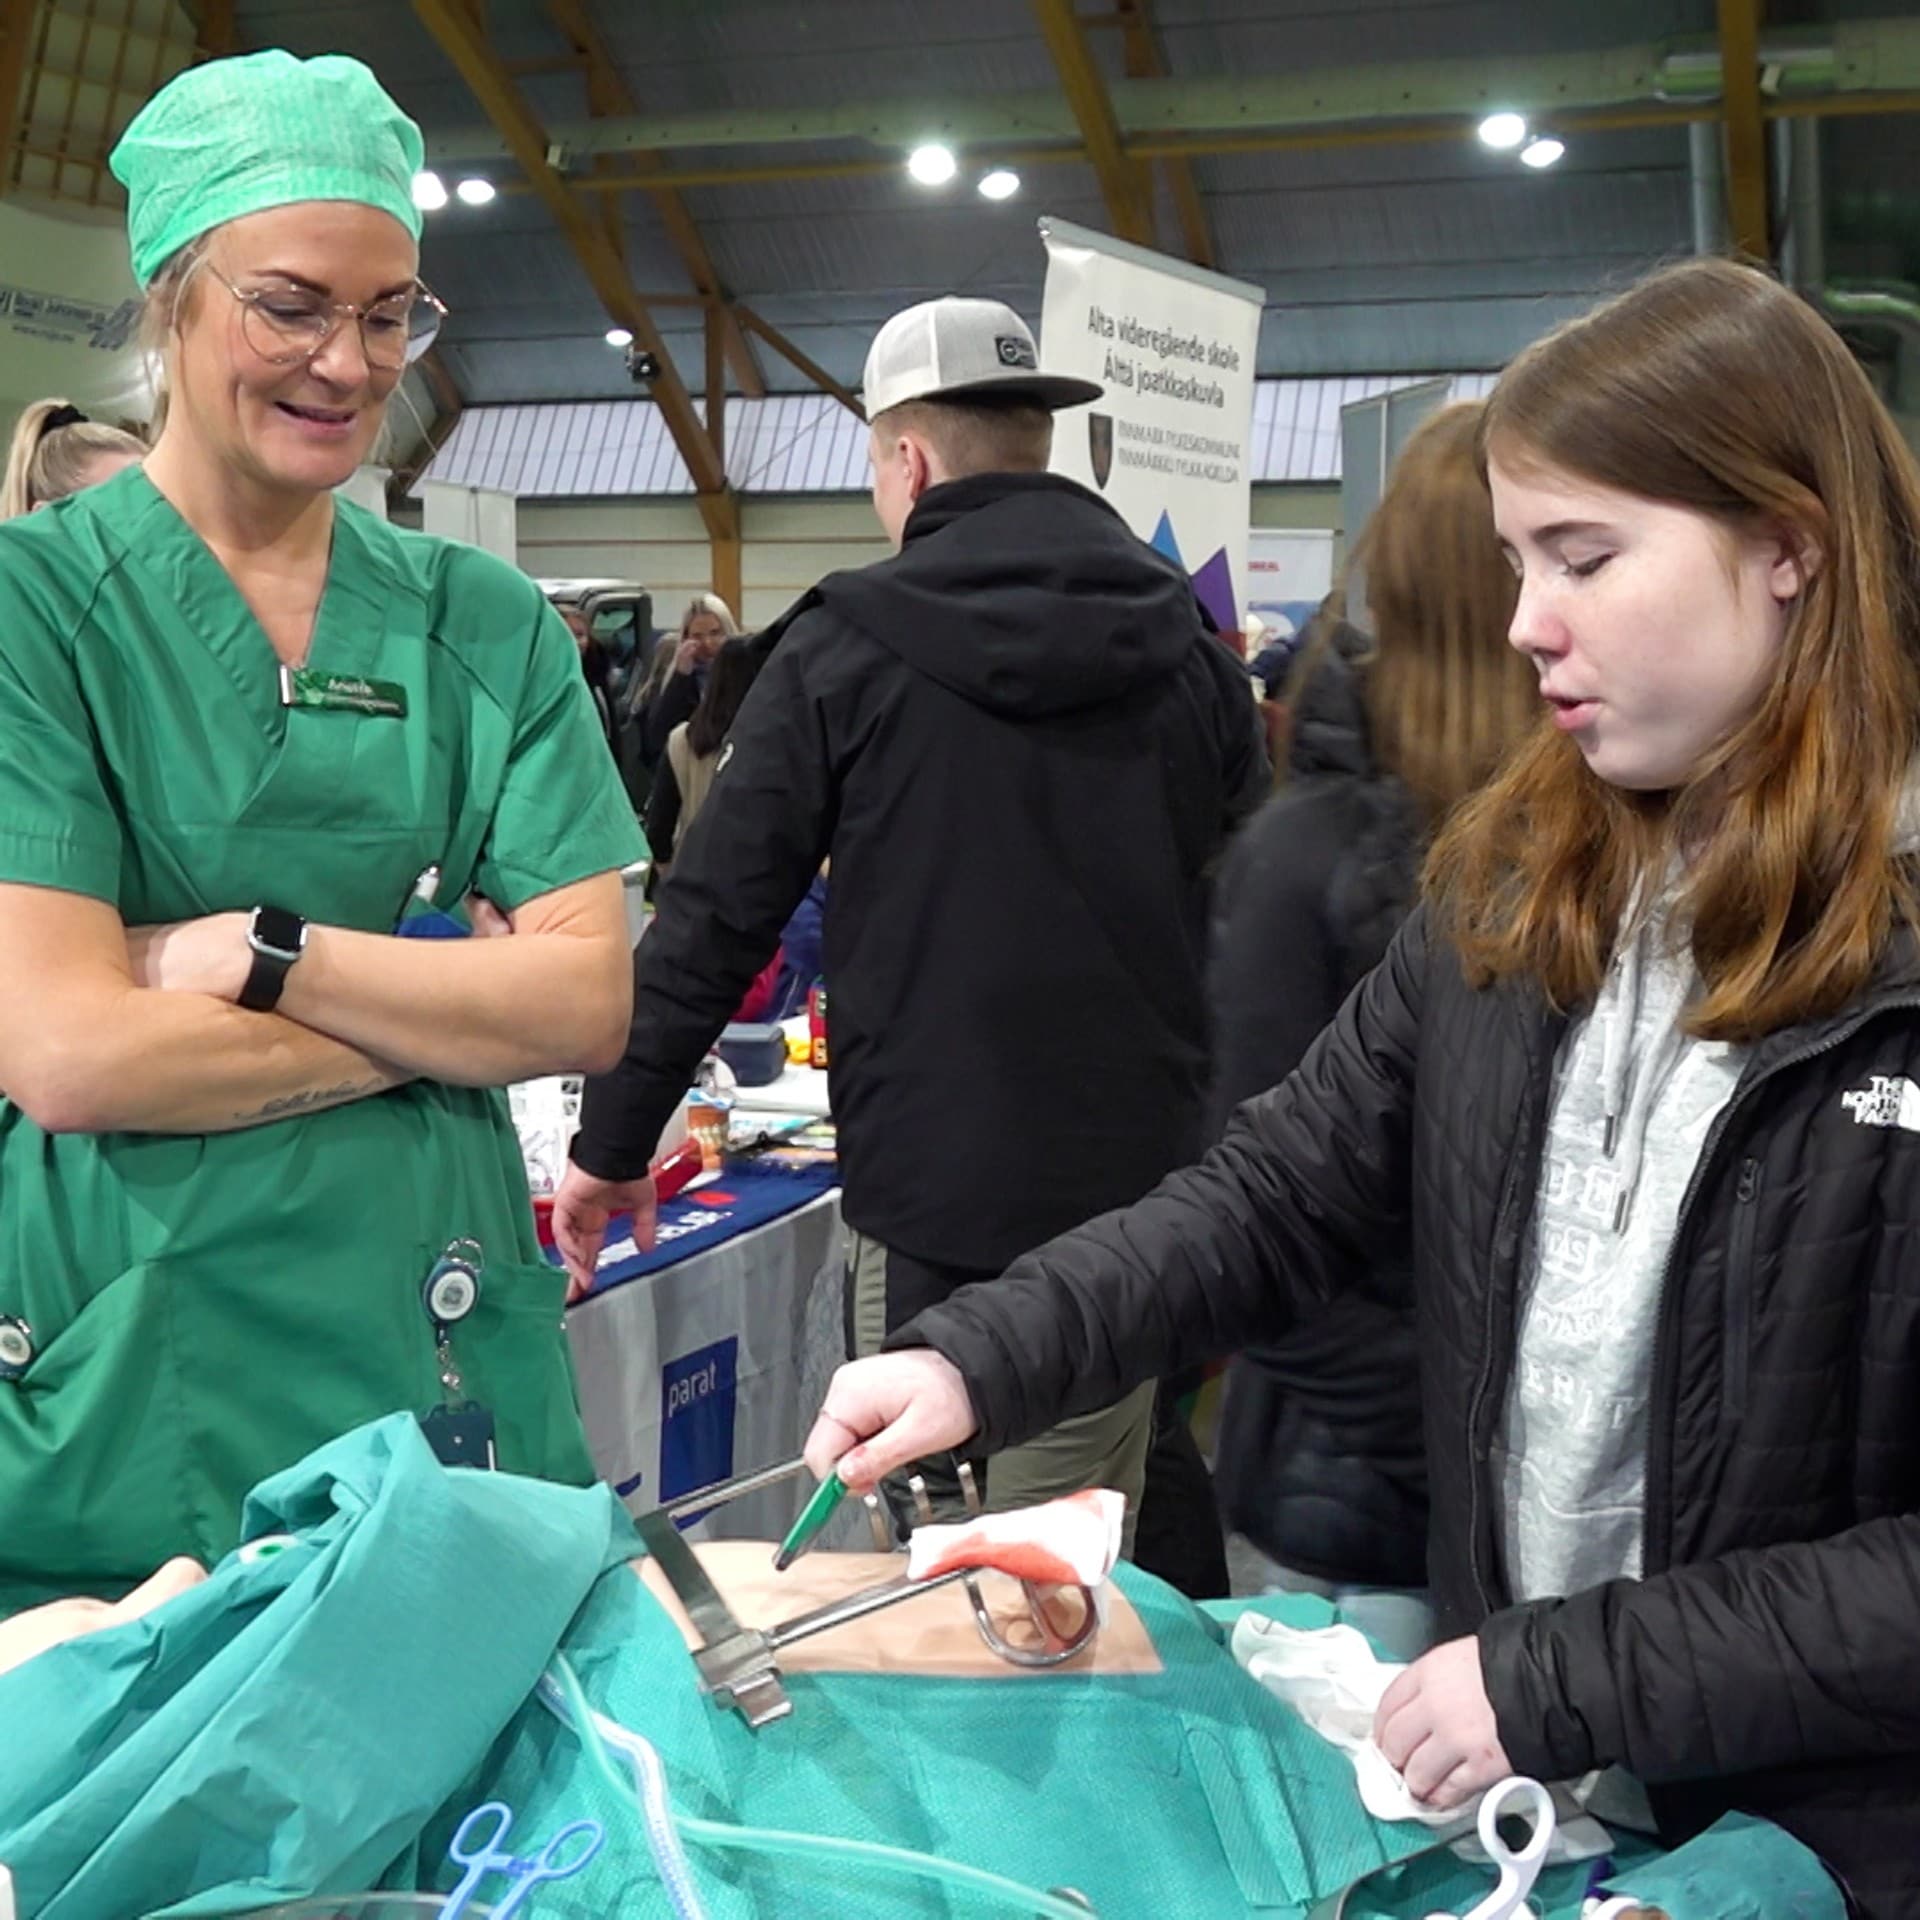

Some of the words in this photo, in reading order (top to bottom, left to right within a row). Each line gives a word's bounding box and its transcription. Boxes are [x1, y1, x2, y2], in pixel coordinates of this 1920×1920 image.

[1088, 306, 1114, 338] Alta
[1208, 341, 1240, 373] skole
[668, 1359, 717, 1418] parat
